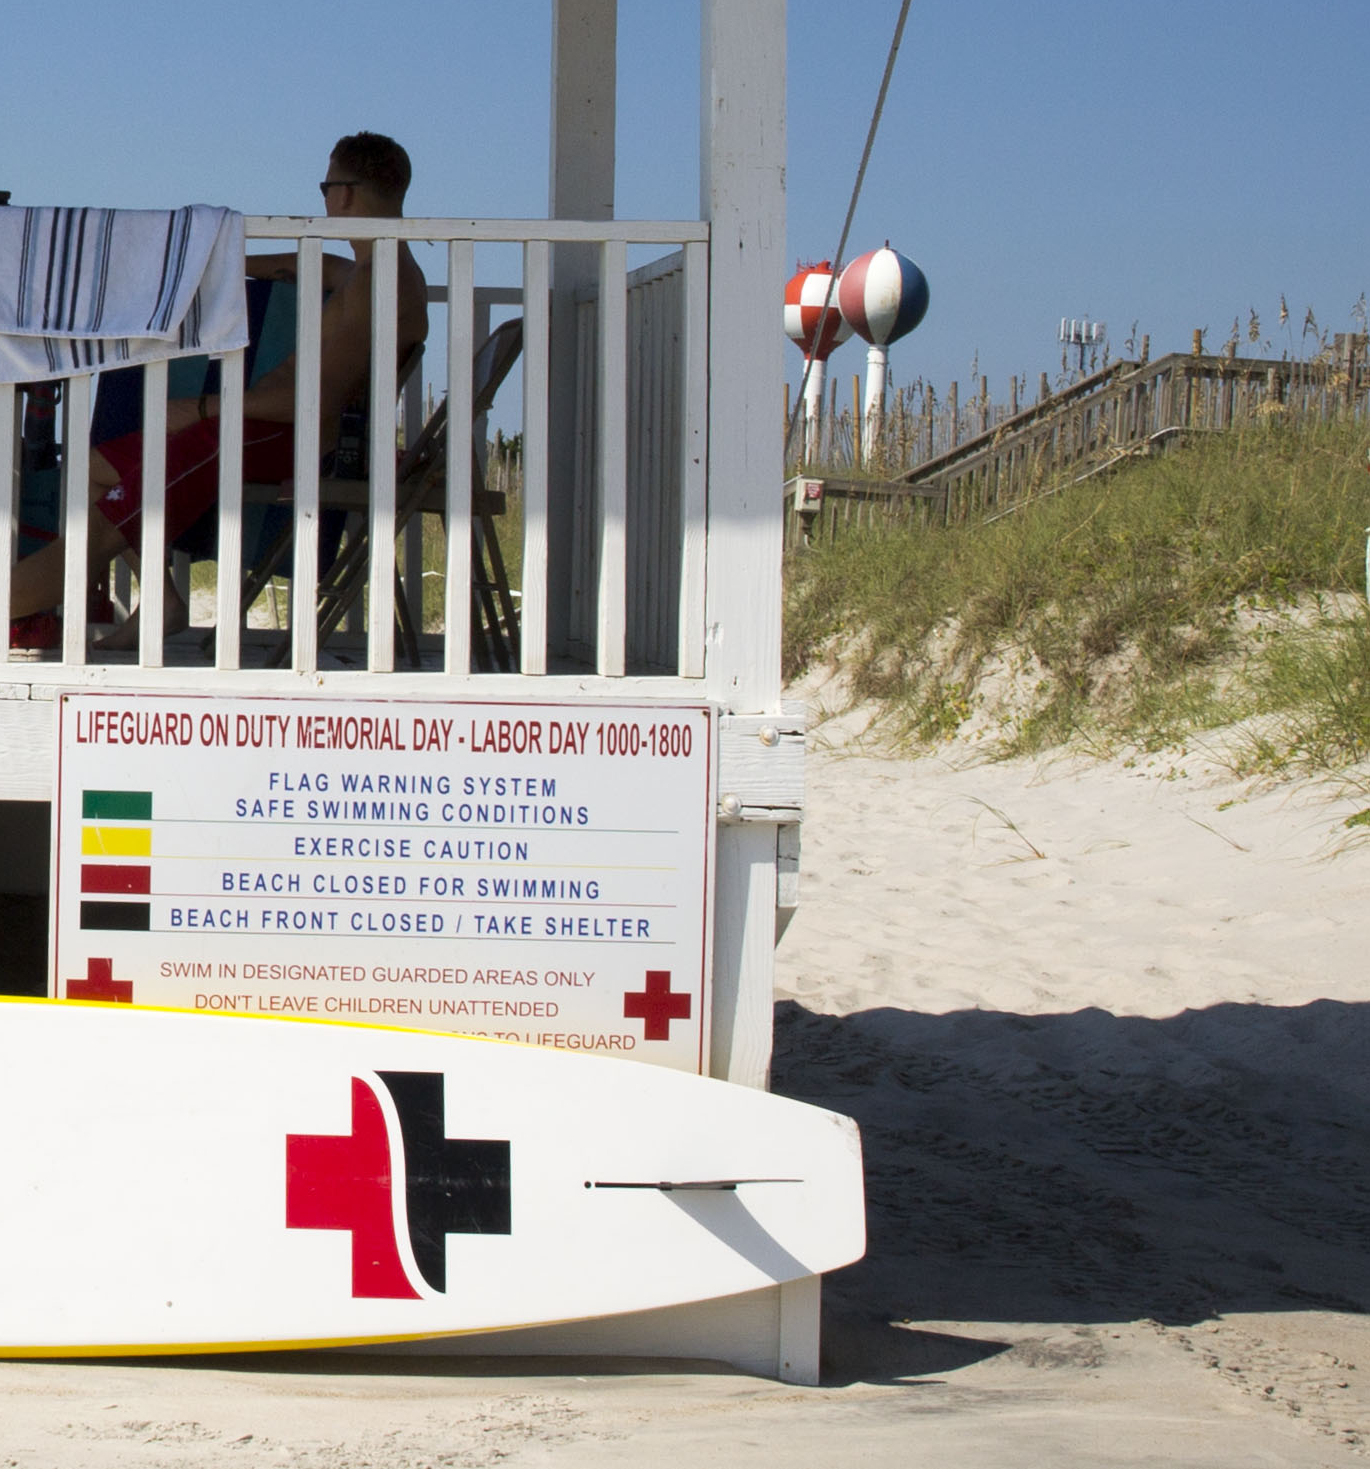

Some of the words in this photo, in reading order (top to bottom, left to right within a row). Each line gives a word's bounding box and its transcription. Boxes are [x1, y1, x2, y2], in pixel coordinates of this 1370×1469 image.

[76, 710, 193, 747] LIFEGUARD
[199, 713, 229, 747] ON
[236, 714, 290, 749] DUTY
[296, 716, 406, 752] MEMORIAL
[413, 719, 453, 752] DAY
[471, 720, 542, 755] LABOR
[549, 721, 590, 756] DAY
[597, 723, 693, 758] 1000-1800
[269, 772, 329, 793] FLAG
[341, 774, 451, 795] WARNING
[463, 776, 557, 797] SYSTEM
[235, 798, 294, 819] SAFE
[307, 800, 429, 823] SWIMMING
[441, 804, 590, 826] CONDITIONS
[294, 837, 411, 858] EXERCISE
[423, 839, 529, 861] CAUTION
[222, 872, 300, 893] BEACH
[313, 874, 406, 896] CLOSED
[419, 877, 464, 897] FOR
[477, 878, 600, 900] SWIMMING
[171, 908, 249, 929] BEACH
[262, 910, 339, 931] FRONT
[350, 912, 444, 934] CLOSED
[473, 915, 532, 935] TAKE
[545, 916, 651, 938] SHELTER
[160, 962, 212, 979] SWIM
[218, 963, 237, 980] IN
[243, 964, 366, 983] DESIGNATED
[372, 966, 468, 985] GUARDED
[473, 969, 538, 986] AREAS
[544, 970, 595, 987] ONLY
[195, 994, 252, 1011] DON'T
[258, 995, 318, 1013] LEAVE
[324, 997, 422, 1015] CHILDREN
[429, 999, 559, 1018] UNATTENDED
